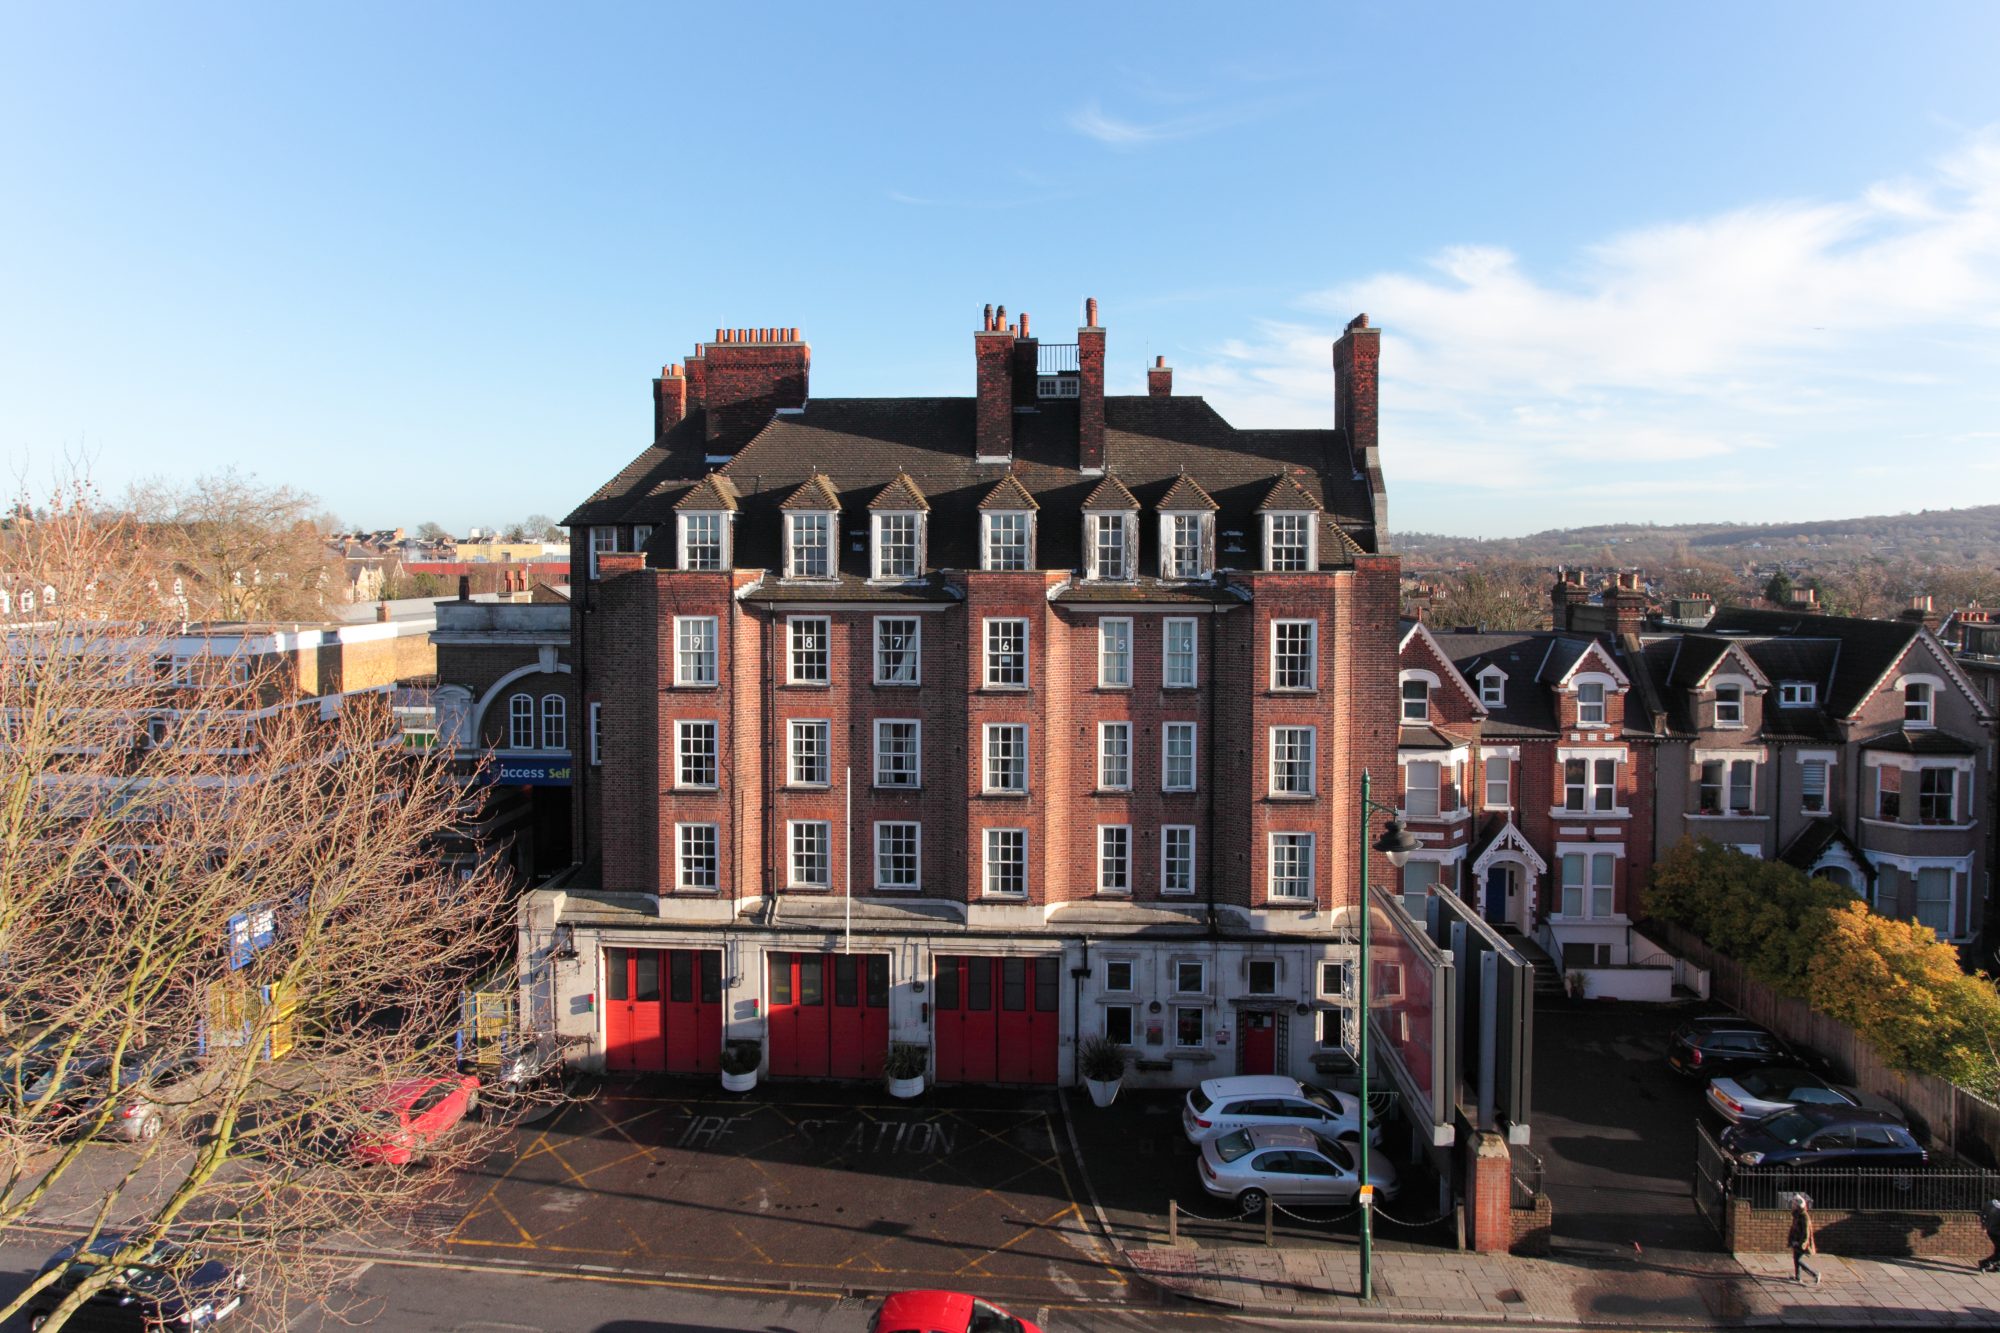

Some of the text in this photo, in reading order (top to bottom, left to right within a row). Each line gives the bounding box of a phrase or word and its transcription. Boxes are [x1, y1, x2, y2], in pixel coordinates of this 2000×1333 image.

[693, 636, 701, 649] 9
[805, 636, 813, 649] 8
[893, 636, 902, 648] 7
[1002, 640, 1010, 651] 6
[1118, 639, 1126, 650] 5
[1183, 639, 1190, 651] 4
[500, 767, 571, 778] access Self
